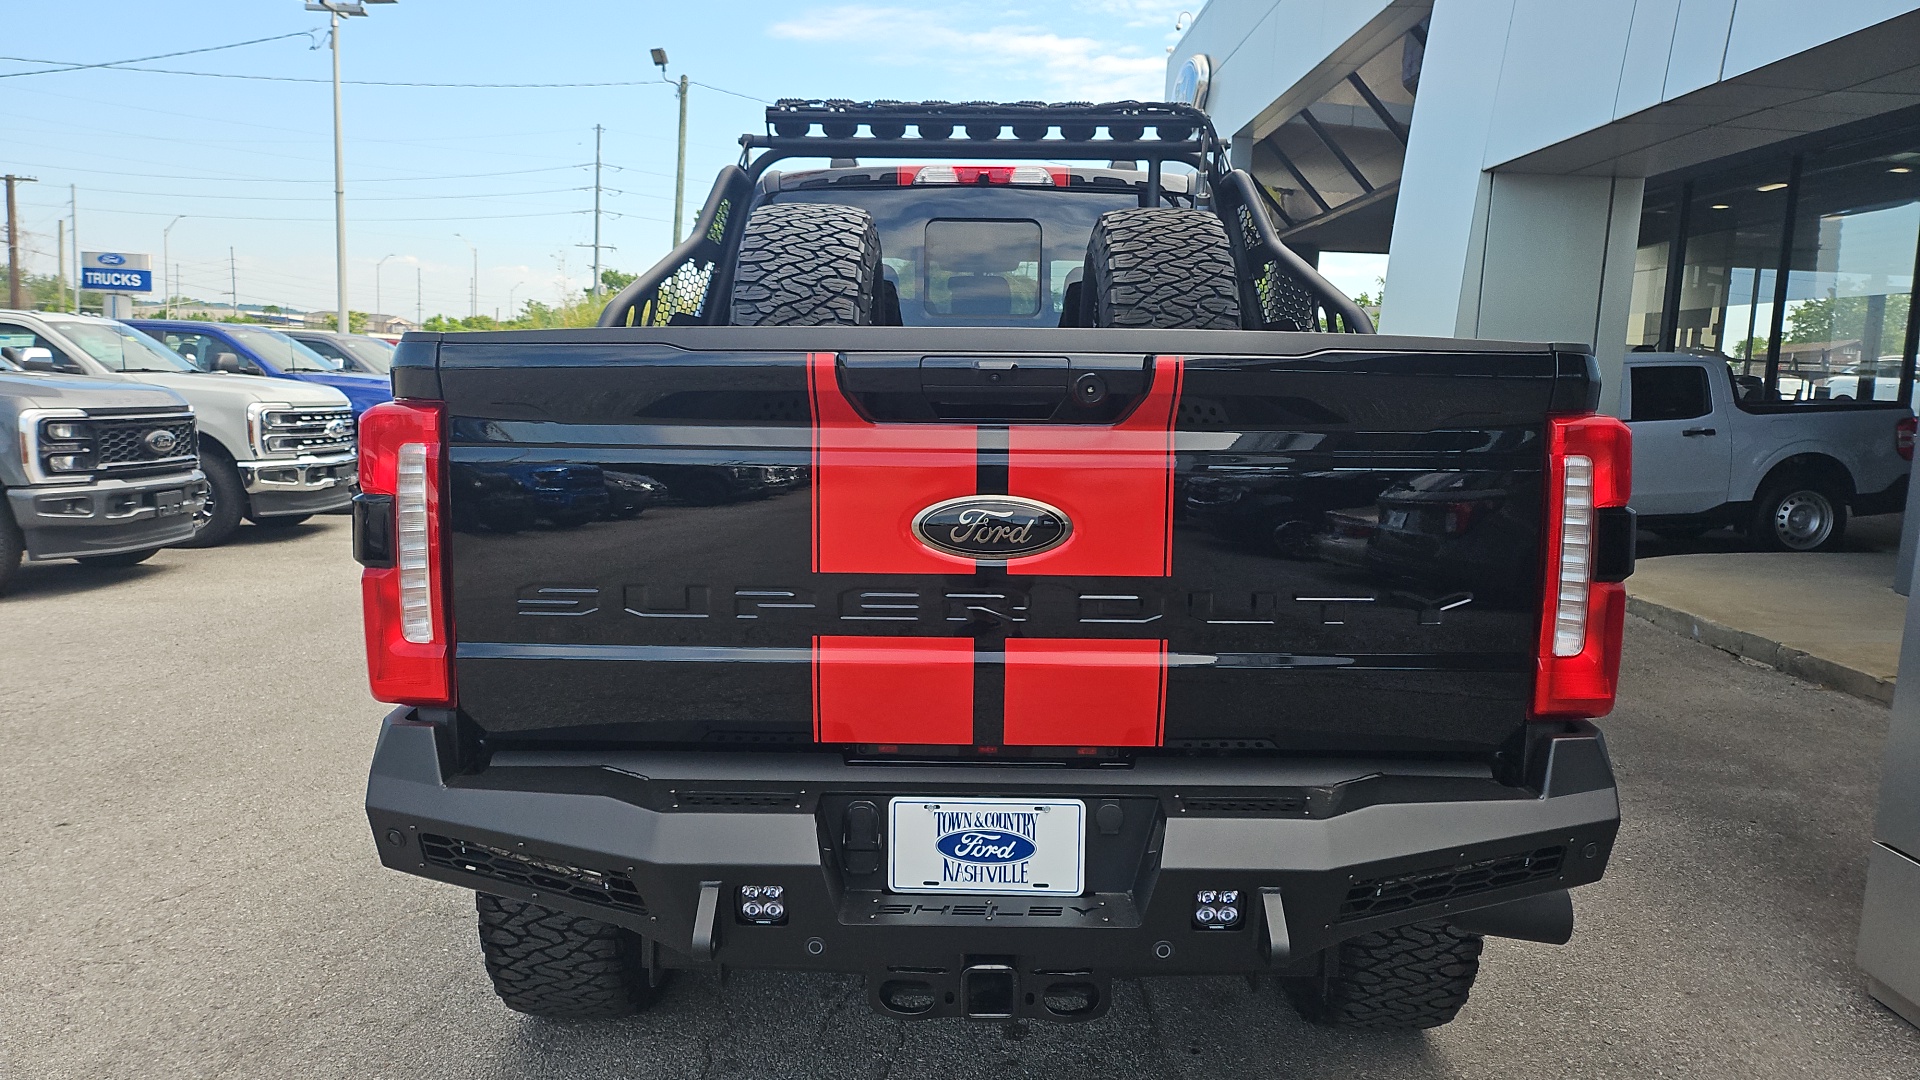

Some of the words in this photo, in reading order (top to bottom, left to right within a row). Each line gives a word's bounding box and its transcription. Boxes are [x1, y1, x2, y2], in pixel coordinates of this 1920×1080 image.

[85, 272, 142, 287] TRUCKS
[950, 508, 1035, 544] Ford
[516, 585, 1030, 622] SUPER
[1076, 590, 1474, 627] DUTY
[933, 811, 973, 838] TOWN
[954, 832, 1017, 859] Ford
[943, 858, 1029, 884] NASHVILLE
[877, 904, 1100, 917] SHELBY
